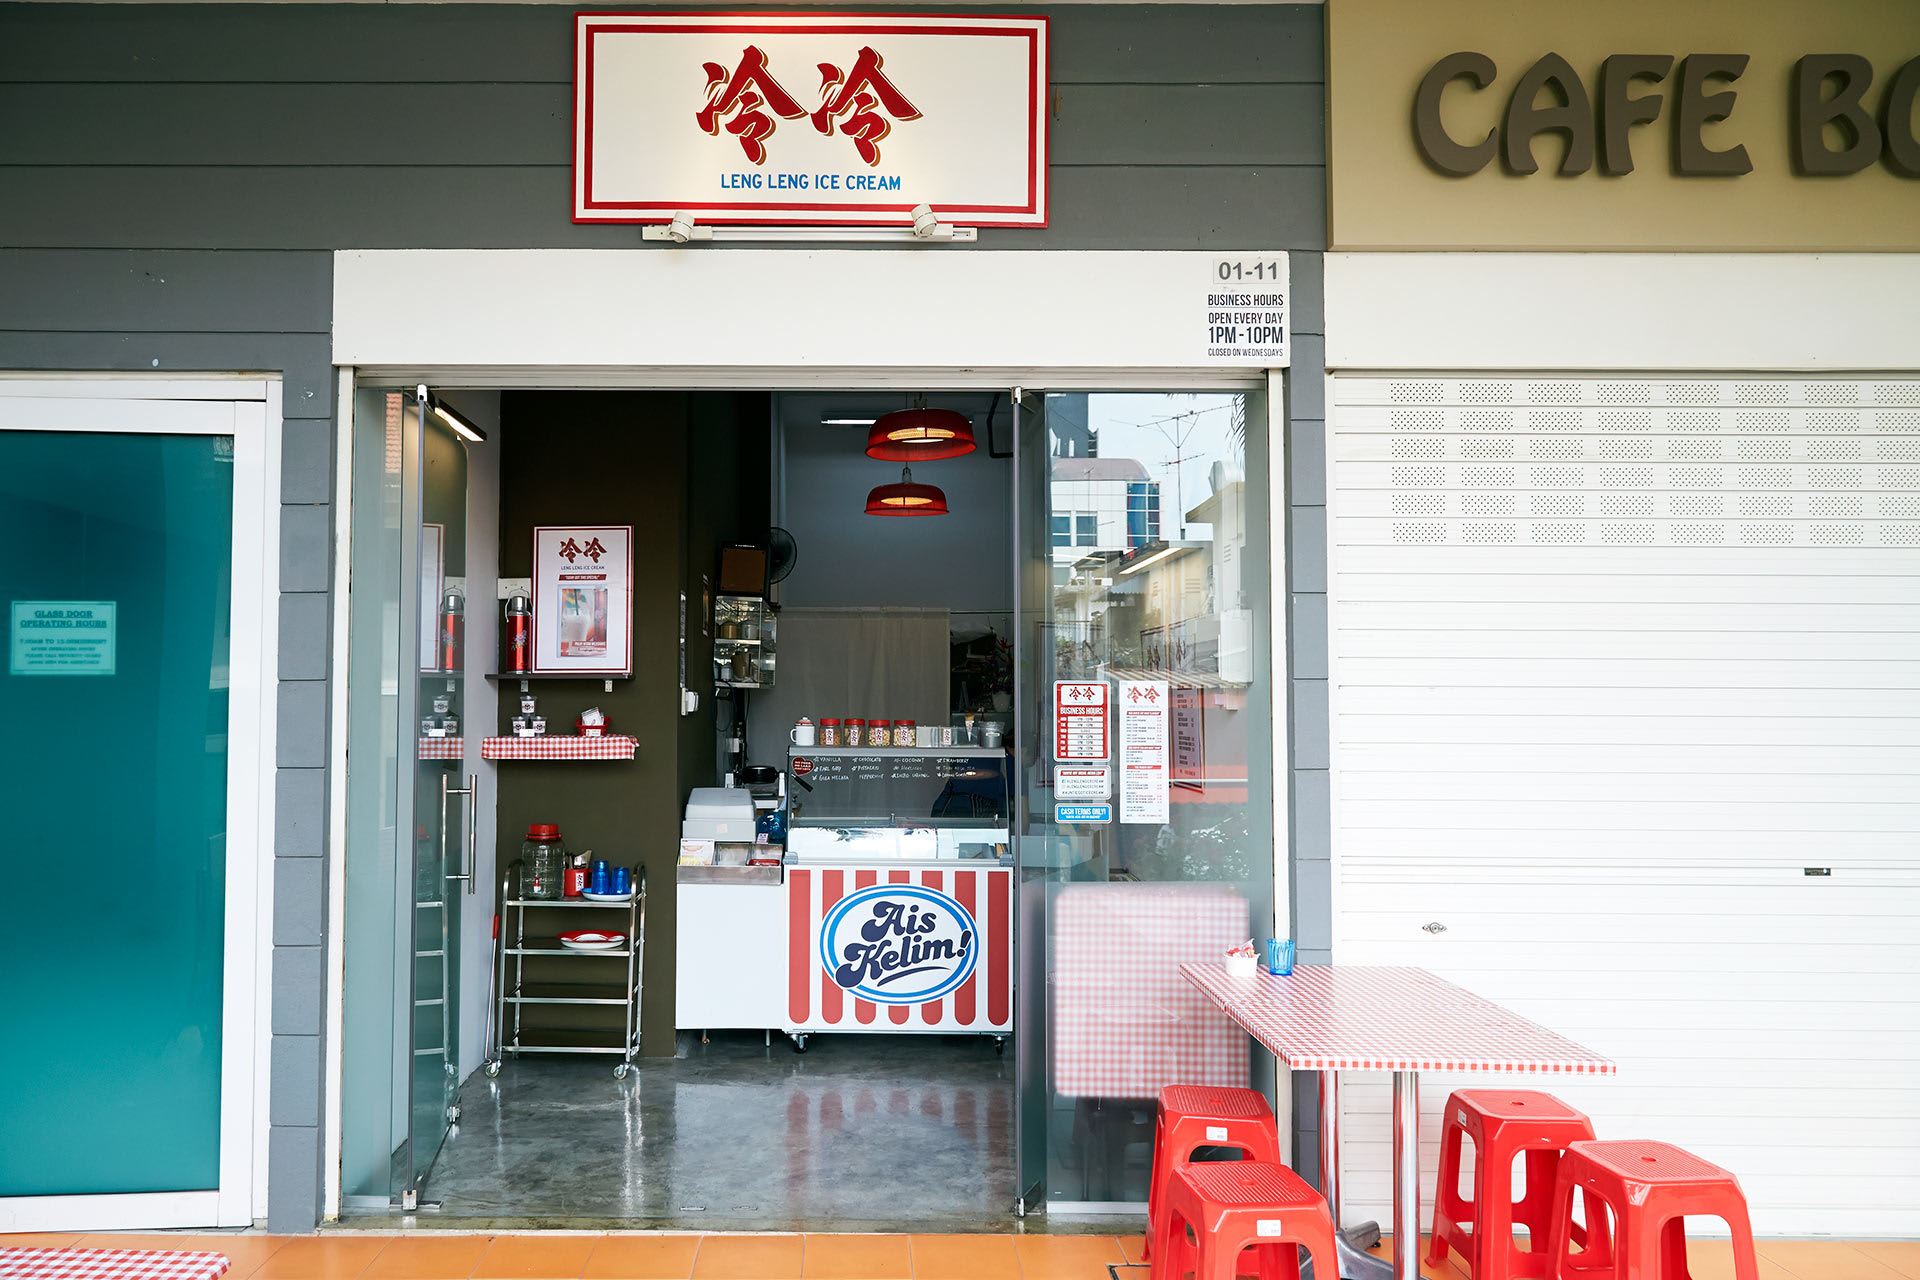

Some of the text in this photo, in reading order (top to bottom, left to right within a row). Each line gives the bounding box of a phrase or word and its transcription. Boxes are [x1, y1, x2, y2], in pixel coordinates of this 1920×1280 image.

[696, 44, 924, 167] 冷冷
[1413, 51, 1754, 177] CAFE
[721, 173, 901, 191] LENG LENG ICE CREAM
[1218, 261, 1278, 280] 01-11
[1208, 294, 1284, 306] BUSINESS HOURS
[1208, 312, 1284, 324] OPEN EVERY DAY
[1208, 326, 1236, 344] 1PM
[1246, 326, 1283, 344] 10PM
[1208, 348, 1284, 357] CLOSED ON WEDNESDAYS
[558, 537, 607, 564] 冷冷
[34, 610, 93, 618] GLASS DOOR
[20, 620, 107, 628] OPERATING HOURS
[1126, 685, 1161, 704] 冷冷
[1060, 706, 1104, 715] BUSINESS HOURS
[860, 900, 937, 943] Ais
[835, 929, 972, 989] Kelim!
